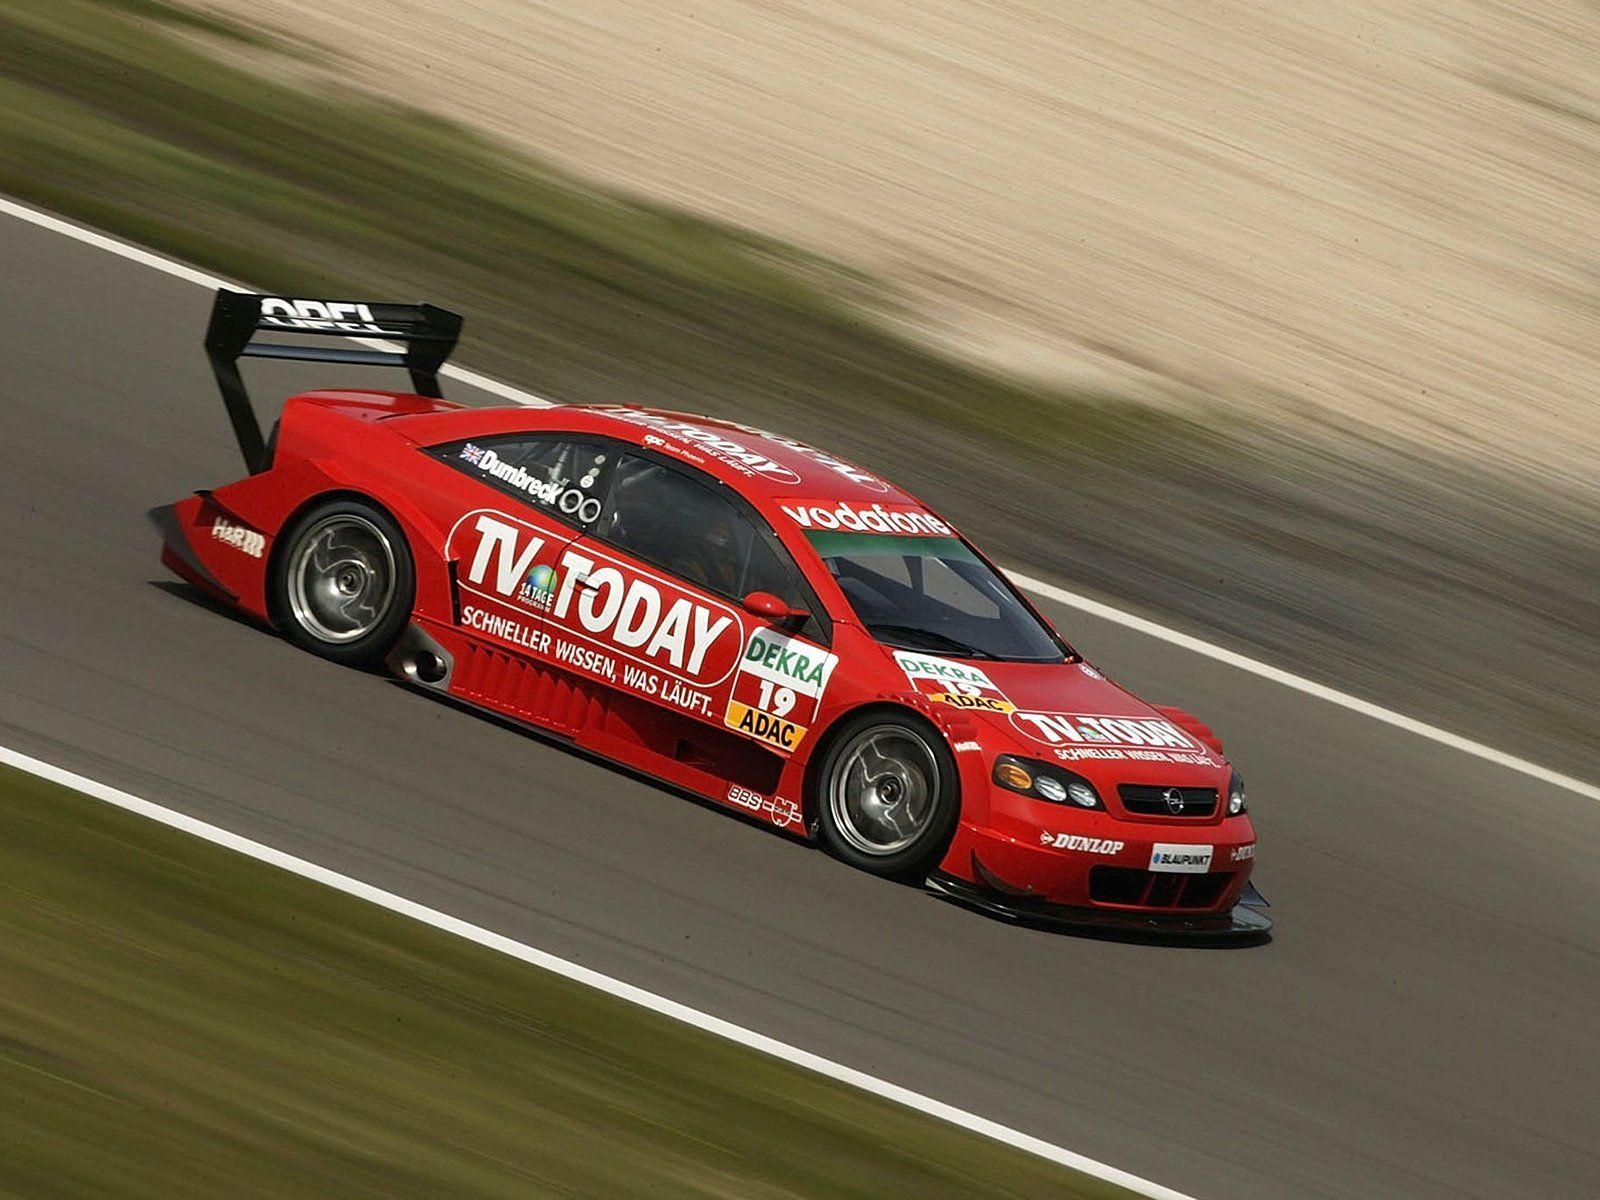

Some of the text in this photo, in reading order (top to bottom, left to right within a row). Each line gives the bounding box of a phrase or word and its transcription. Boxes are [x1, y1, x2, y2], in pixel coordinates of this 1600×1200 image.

[478, 449, 565, 505] Dumbreck
[780, 501, 951, 535] vodafone
[468, 515, 733, 676] TV TODAY
[461, 605, 713, 718] SCHNELLER WISSEN, WAS LÄUFT.
[745, 635, 825, 688] DEKRA
[899, 658, 990, 685] DEKRA
[757, 679, 797, 717] 19
[943, 694, 1005, 711] ADAC
[738, 708, 796, 748] ADAC
[1016, 712, 1195, 749] TV TODAY
[1054, 748, 1125, 761] SCHNELLER
[727, 784, 763, 811] BBS
[1051, 833, 1125, 856] DUNLOP
[1160, 852, 1211, 867] BLAUPUNKT
